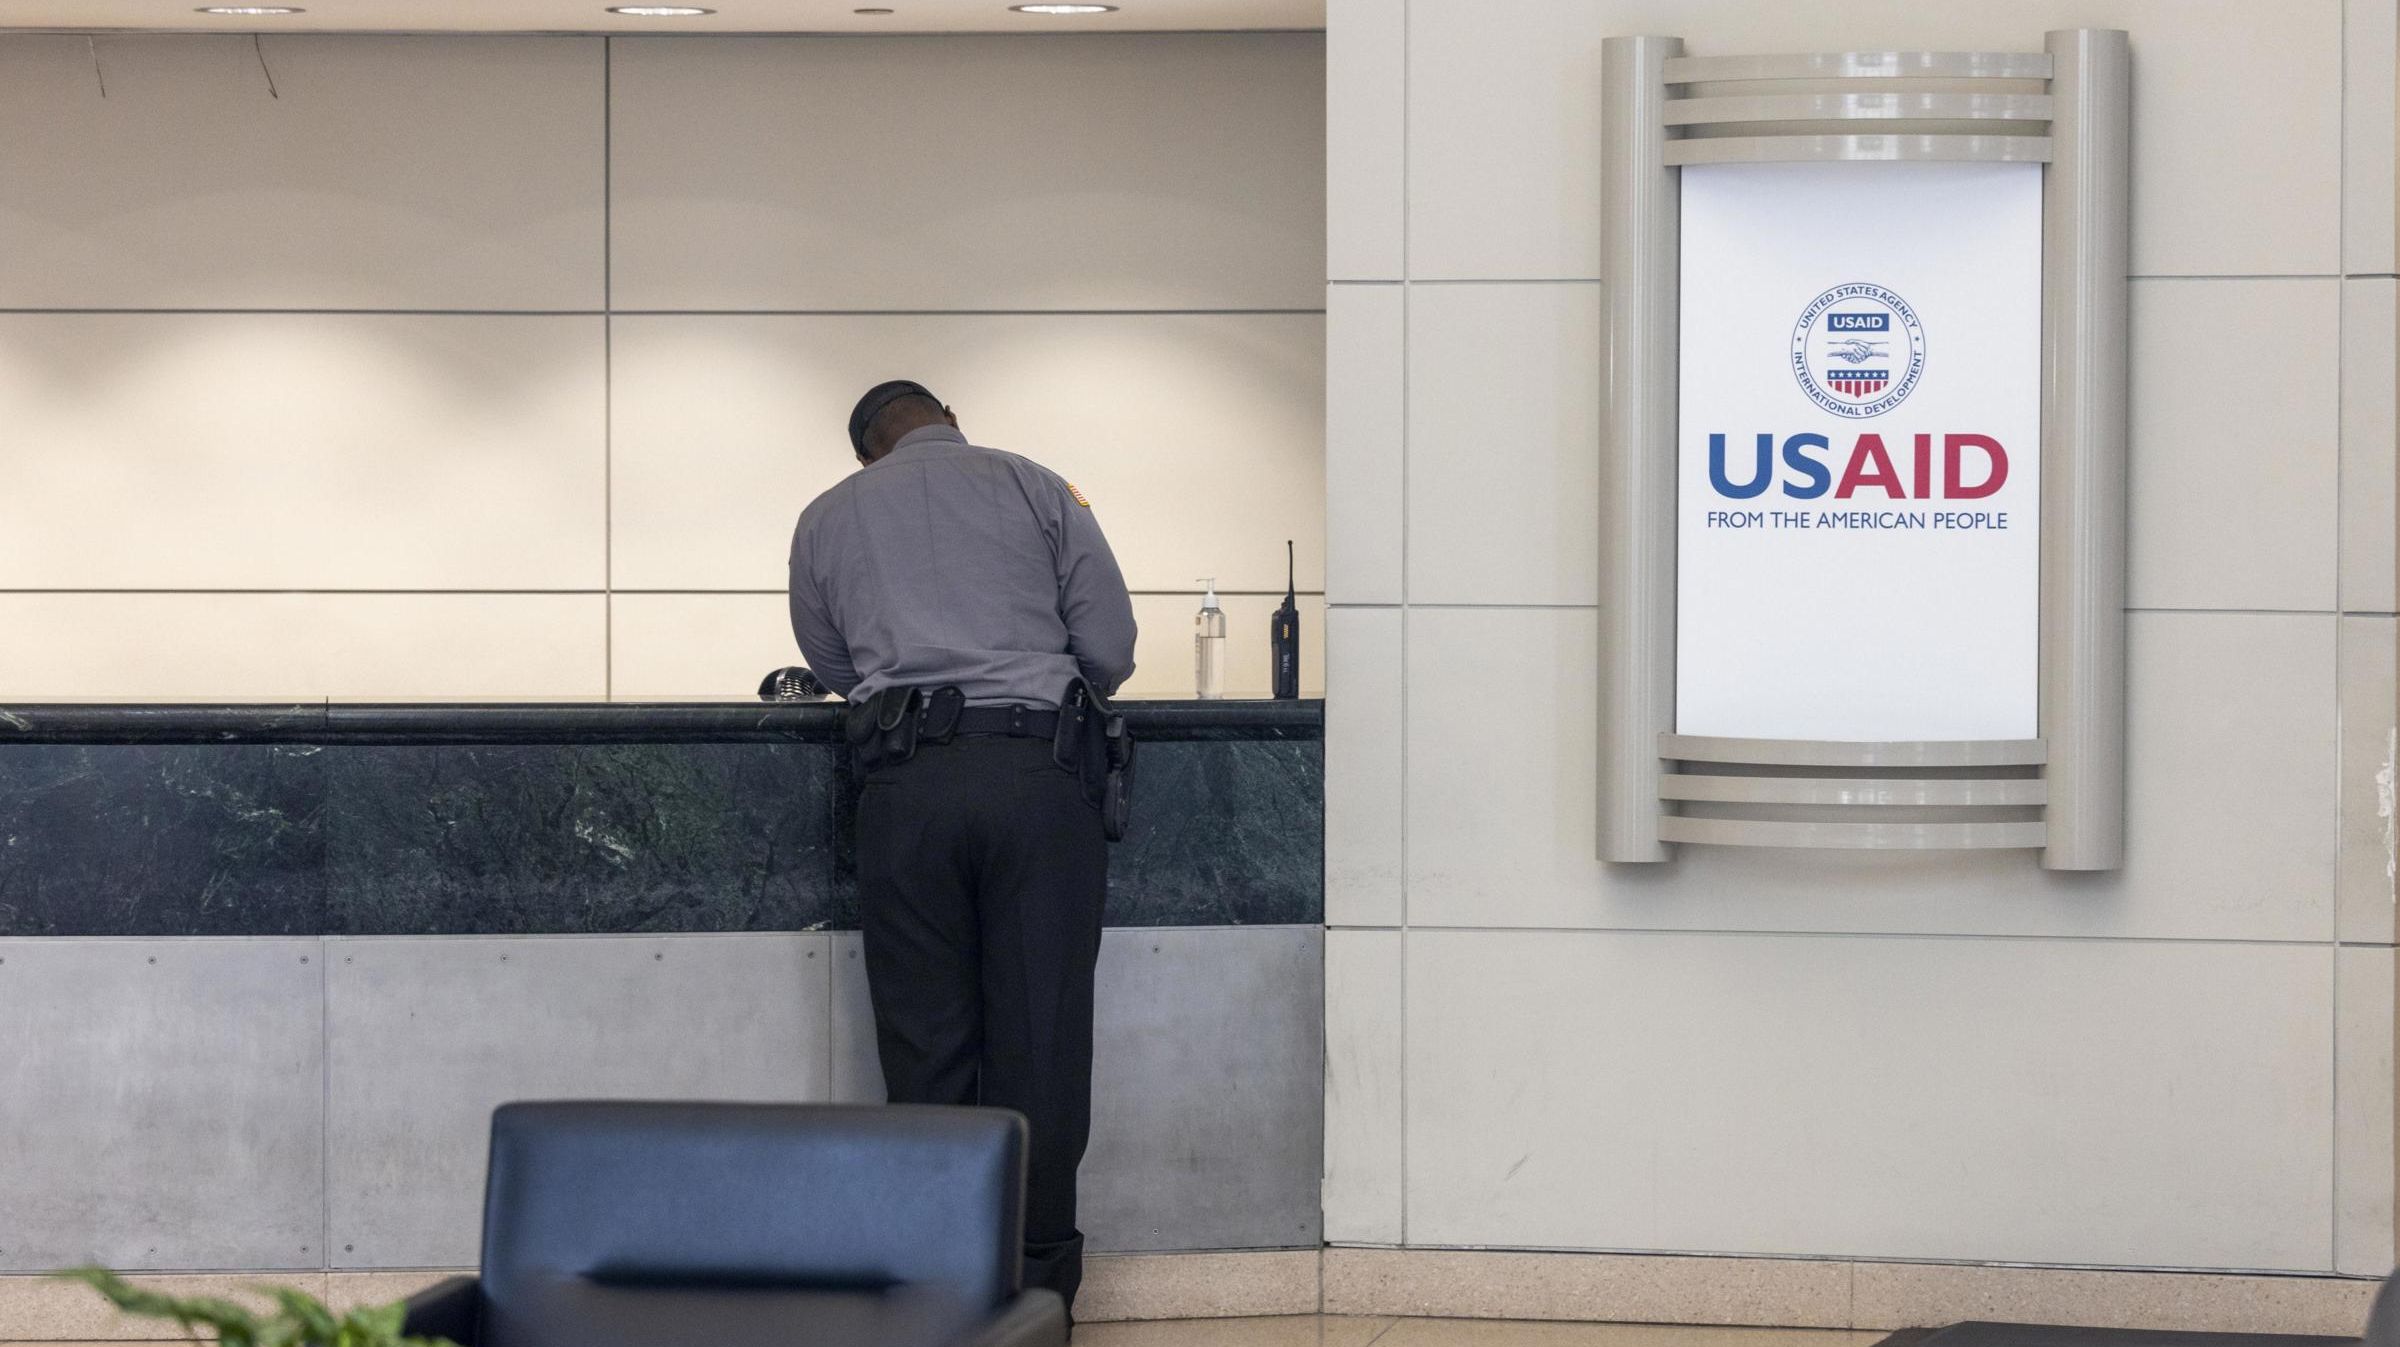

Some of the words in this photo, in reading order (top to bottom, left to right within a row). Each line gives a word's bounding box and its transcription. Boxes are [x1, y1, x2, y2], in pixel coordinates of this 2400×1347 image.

[1799, 292, 1835, 330] UNITED
[1836, 286, 1879, 298] STATES
[1879, 292, 1918, 329] AGENCY
[1833, 316, 1884, 329] USAID
[1794, 351, 1862, 416] INTERNATIONAL
[1864, 350, 1923, 416] DEVELOPMENT
[1709, 432, 2009, 500] USAID
[1707, 511, 1764, 529] FROM
[1769, 511, 1811, 529] THE
[1816, 511, 1926, 530] AMERICAN
[1933, 512, 2009, 530] PEOPLE
